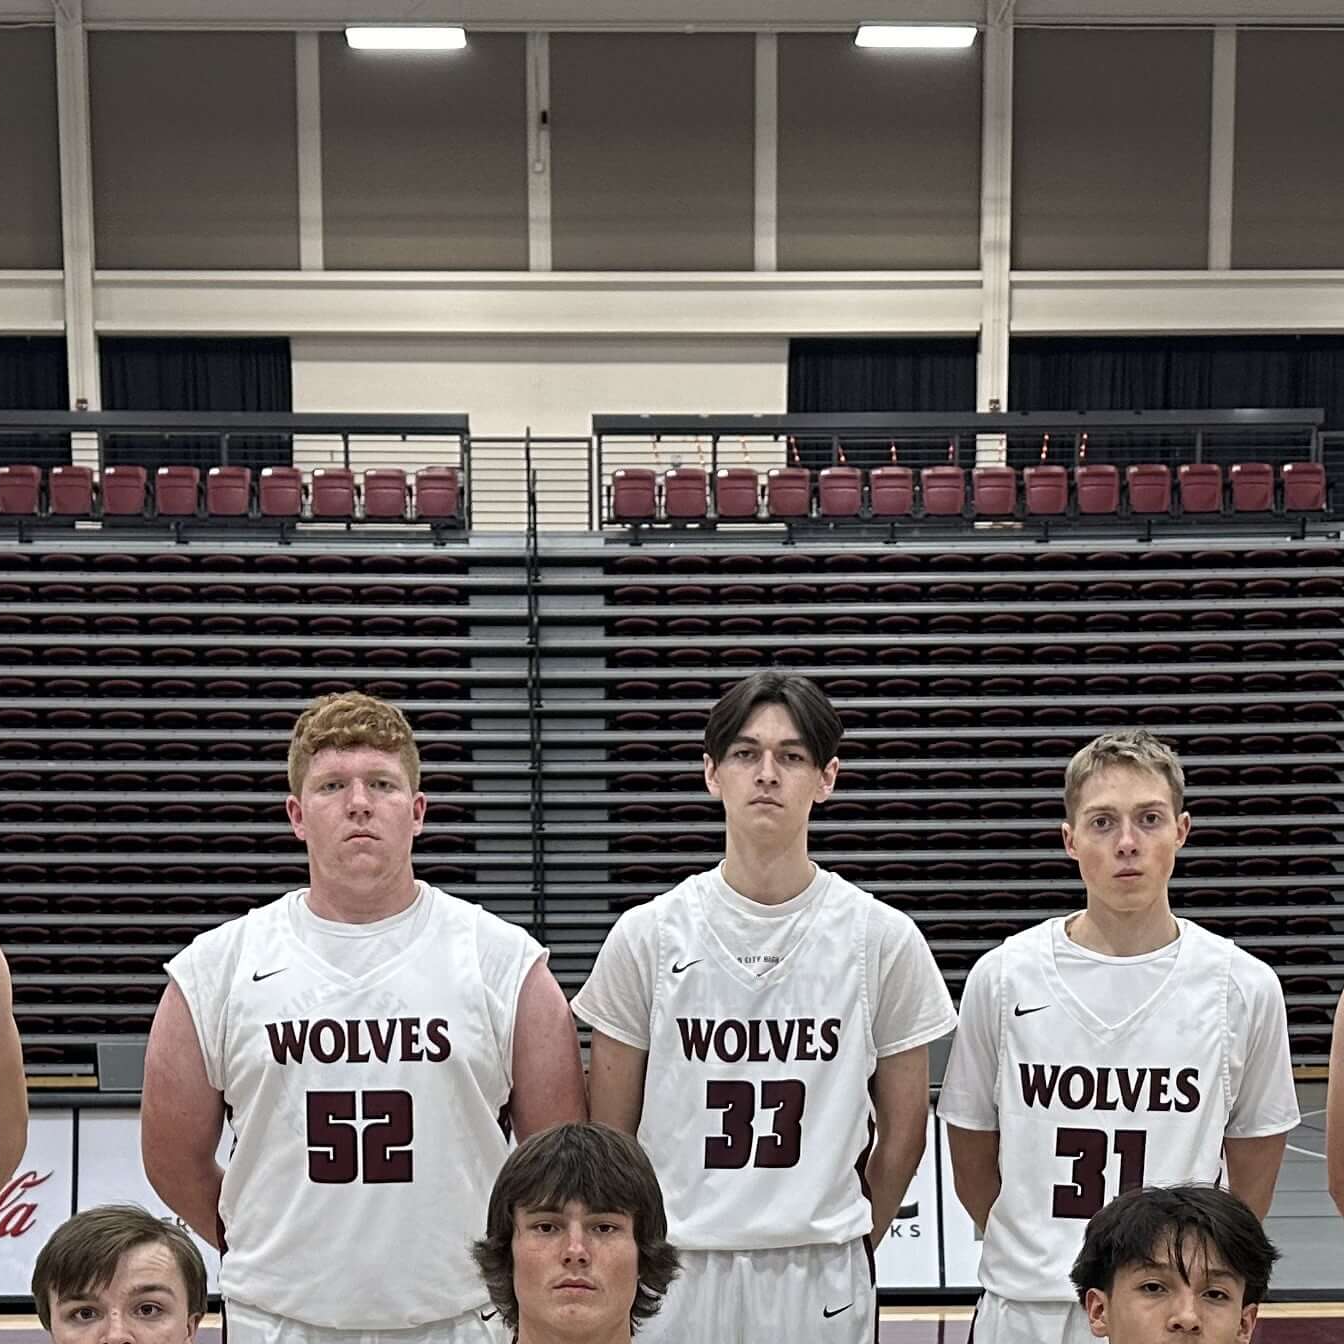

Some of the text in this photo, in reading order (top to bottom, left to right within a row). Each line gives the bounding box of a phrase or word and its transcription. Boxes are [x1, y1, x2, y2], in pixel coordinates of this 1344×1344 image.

[264, 1017, 452, 1066] WOLVES
[675, 1018, 842, 1064] WOLVES
[1018, 1063, 1201, 1113] WOLVES
[305, 1089, 414, 1185] 52
[703, 1078, 806, 1170] 33
[1052, 1126, 1148, 1220] 31
[890, 1223, 921, 1238] KS
